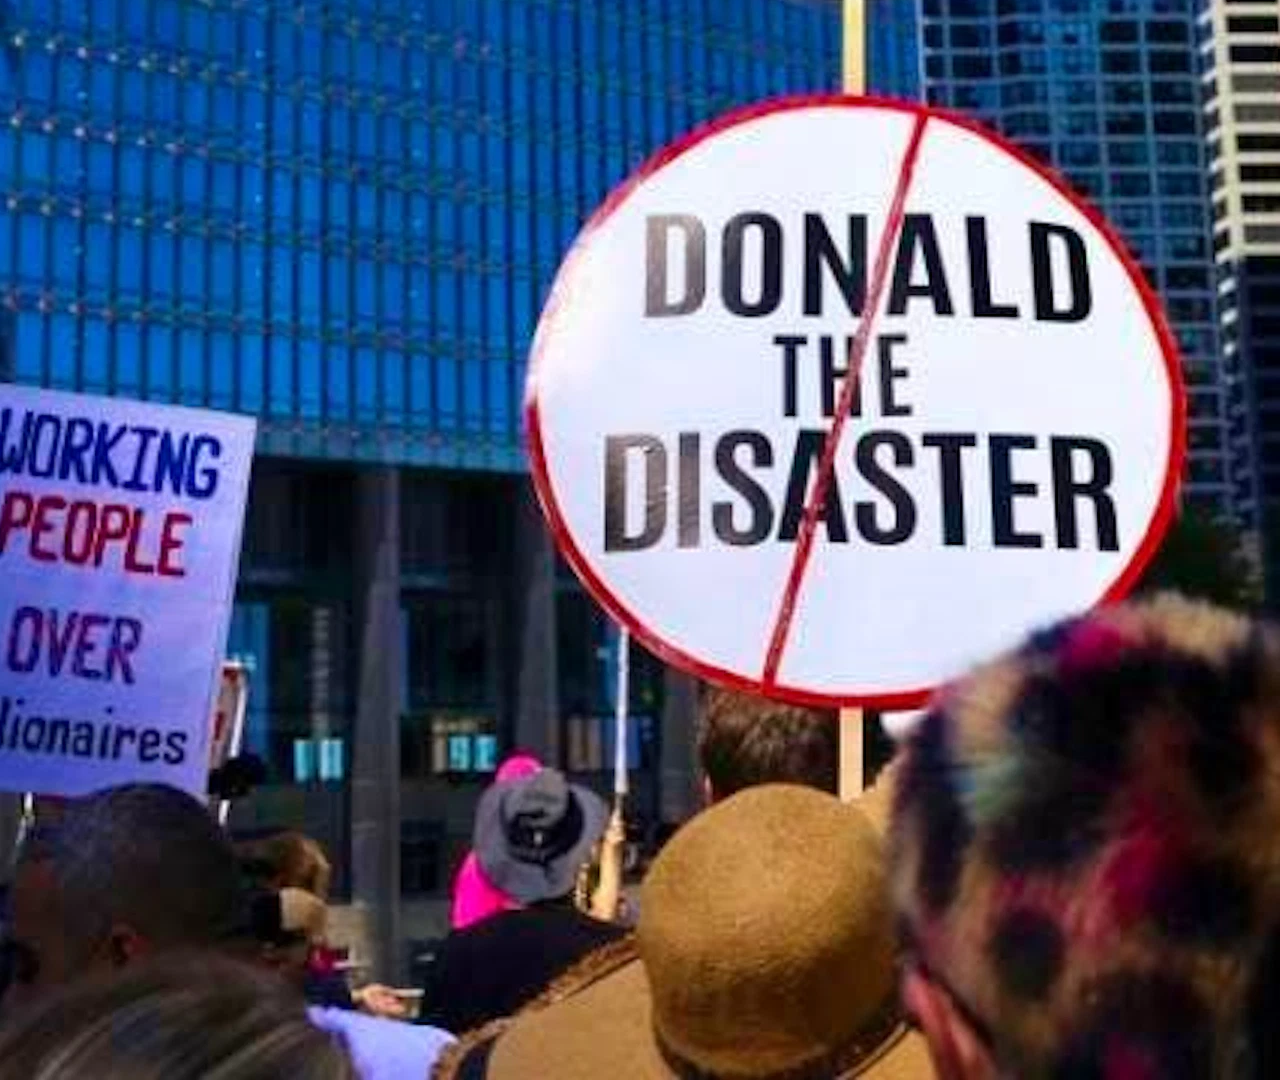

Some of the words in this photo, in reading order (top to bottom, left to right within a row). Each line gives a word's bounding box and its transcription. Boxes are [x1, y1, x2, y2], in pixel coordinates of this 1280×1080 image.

[643, 211, 1094, 322] DONALD
[773, 333, 913, 418] THE
[603, 429, 1120, 552] DISASTER
[6, 606, 142, 685] OVER
